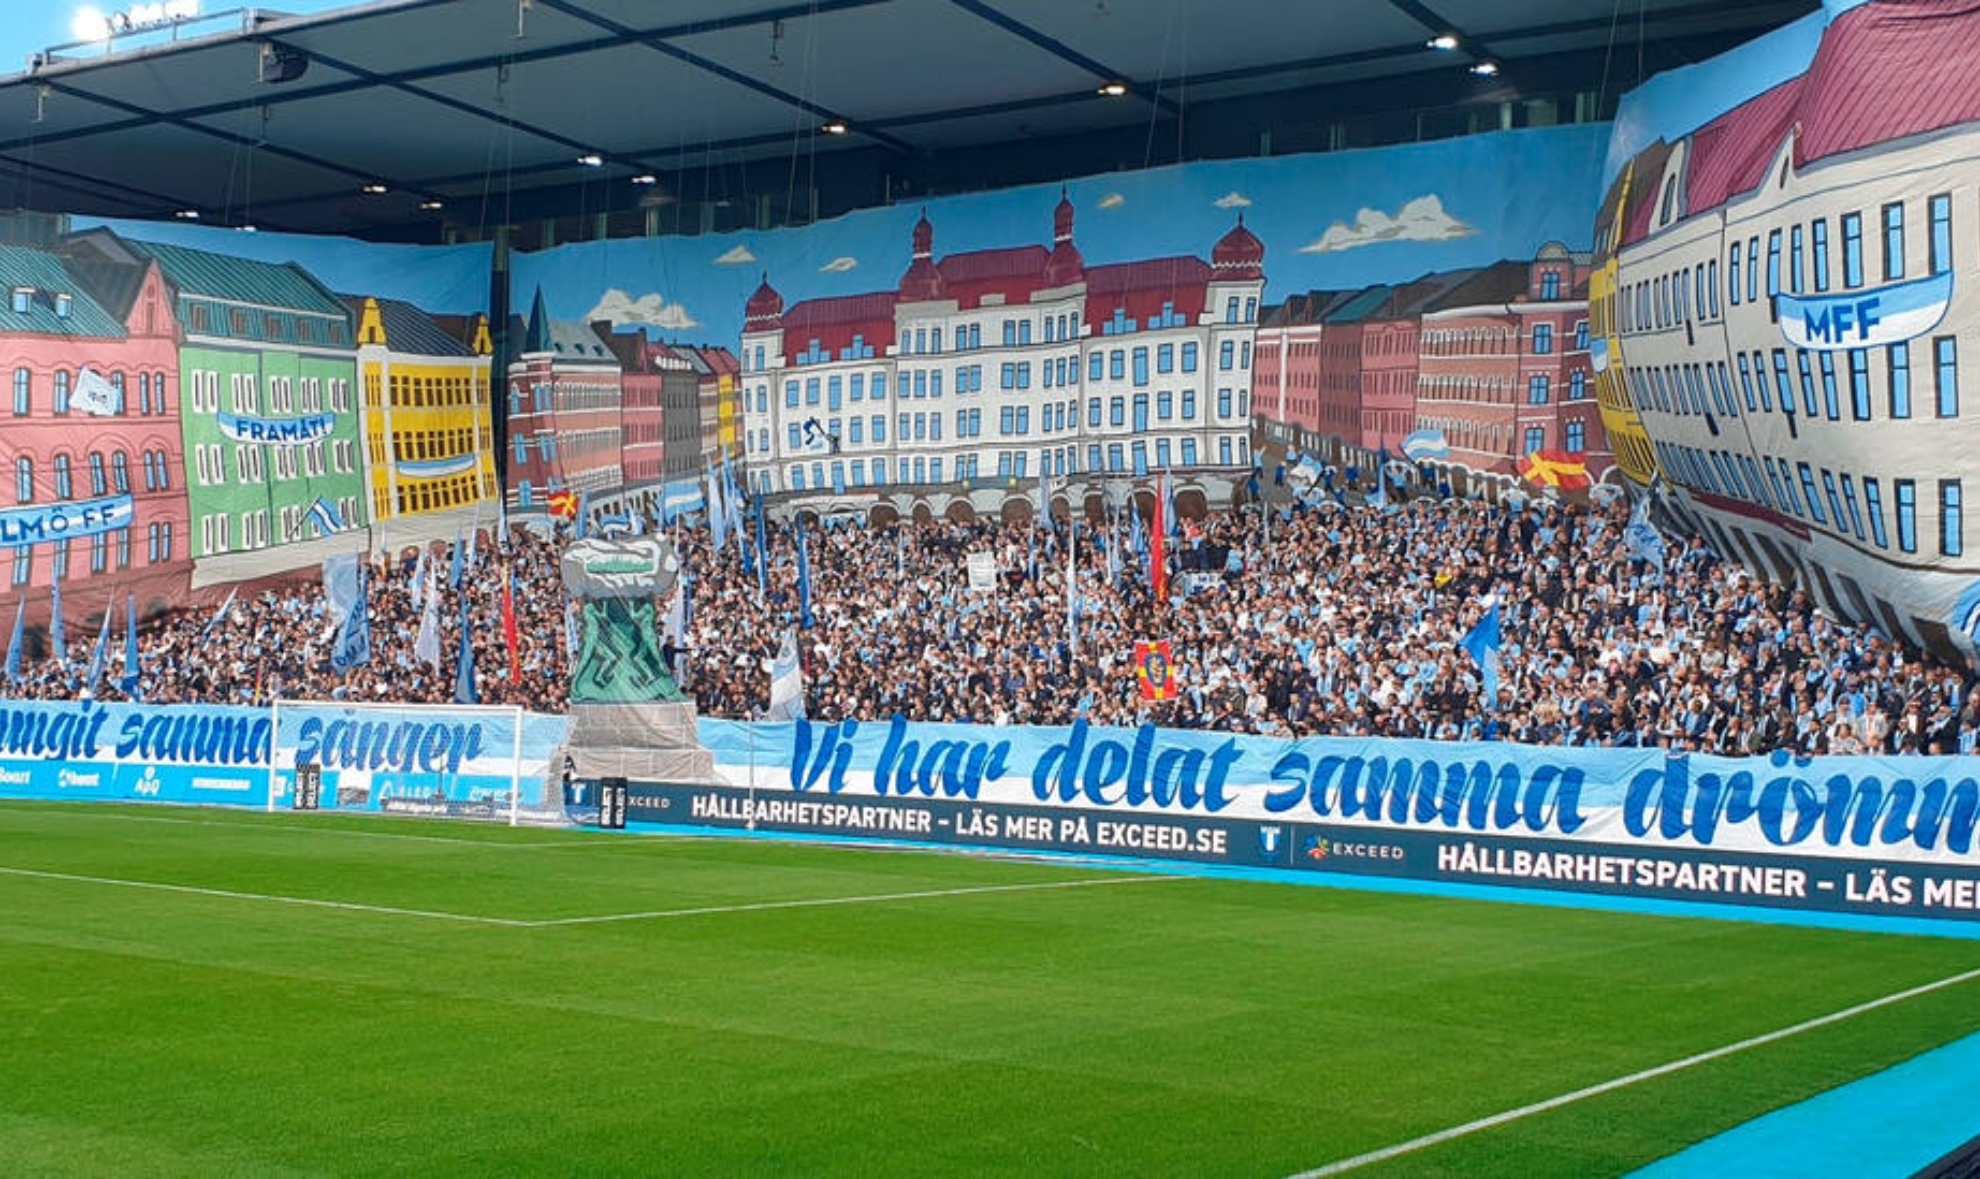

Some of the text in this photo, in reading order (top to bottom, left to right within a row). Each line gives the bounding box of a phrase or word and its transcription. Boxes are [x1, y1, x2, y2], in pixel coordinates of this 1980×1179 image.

[1803, 296, 1880, 344] MFF
[236, 418, 327, 441] FRAMÅT!
[83, 503, 115, 528] FF
[115, 712, 282, 765] samma
[790, 714, 860, 793] Vi
[873, 712, 1010, 800] har
[1032, 717, 1246, 812] delat
[1263, 752, 1588, 834] samma
[627, 795, 671, 809] XCEED
[691, 792, 931, 833] HÅLLBARHETSPARTNER
[956, 808, 999, 837] LÄS
[1005, 815, 1054, 842] MER
[1060, 815, 1090, 844] PÅ
[1096, 821, 1228, 854] EXCEED.SE
[1332, 842, 1405, 859] EXCEED
[1437, 841, 1807, 898] HÅLLBARHETSPARTNER
[1846, 868, 1914, 905] LÄS
[1923, 877, 1980, 909] ME
